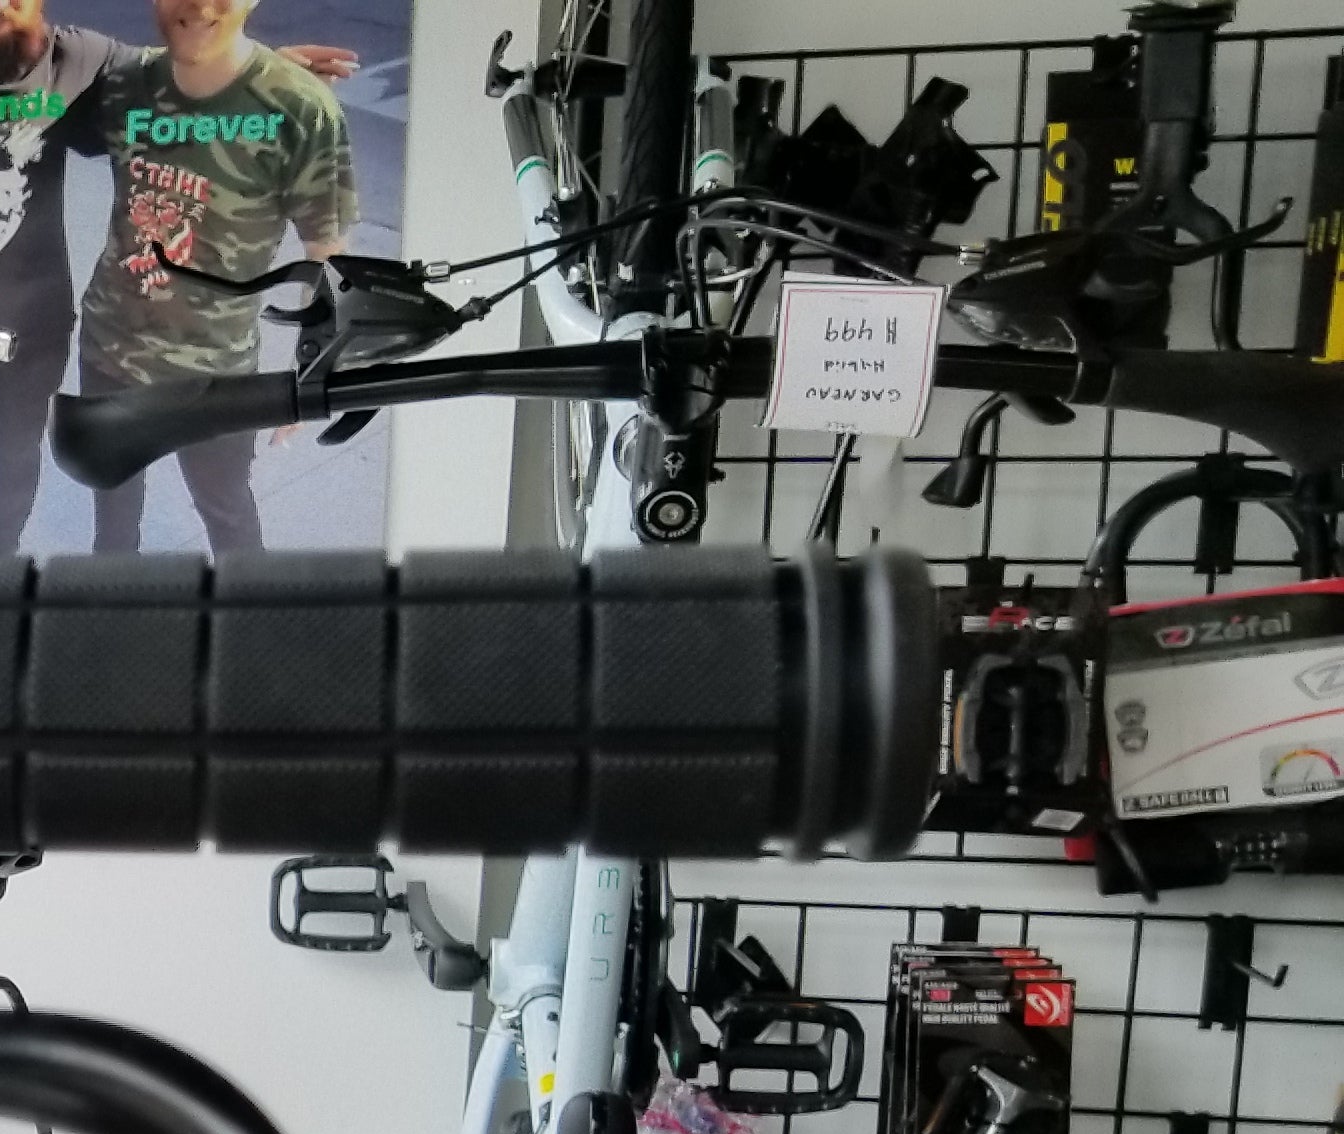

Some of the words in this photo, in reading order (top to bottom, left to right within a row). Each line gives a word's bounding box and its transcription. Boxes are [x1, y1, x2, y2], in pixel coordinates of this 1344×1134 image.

[125, 108, 285, 145] Forever
[804, 386, 902, 404] GARNEAU
[1198, 612, 1291, 642] Zéfal
